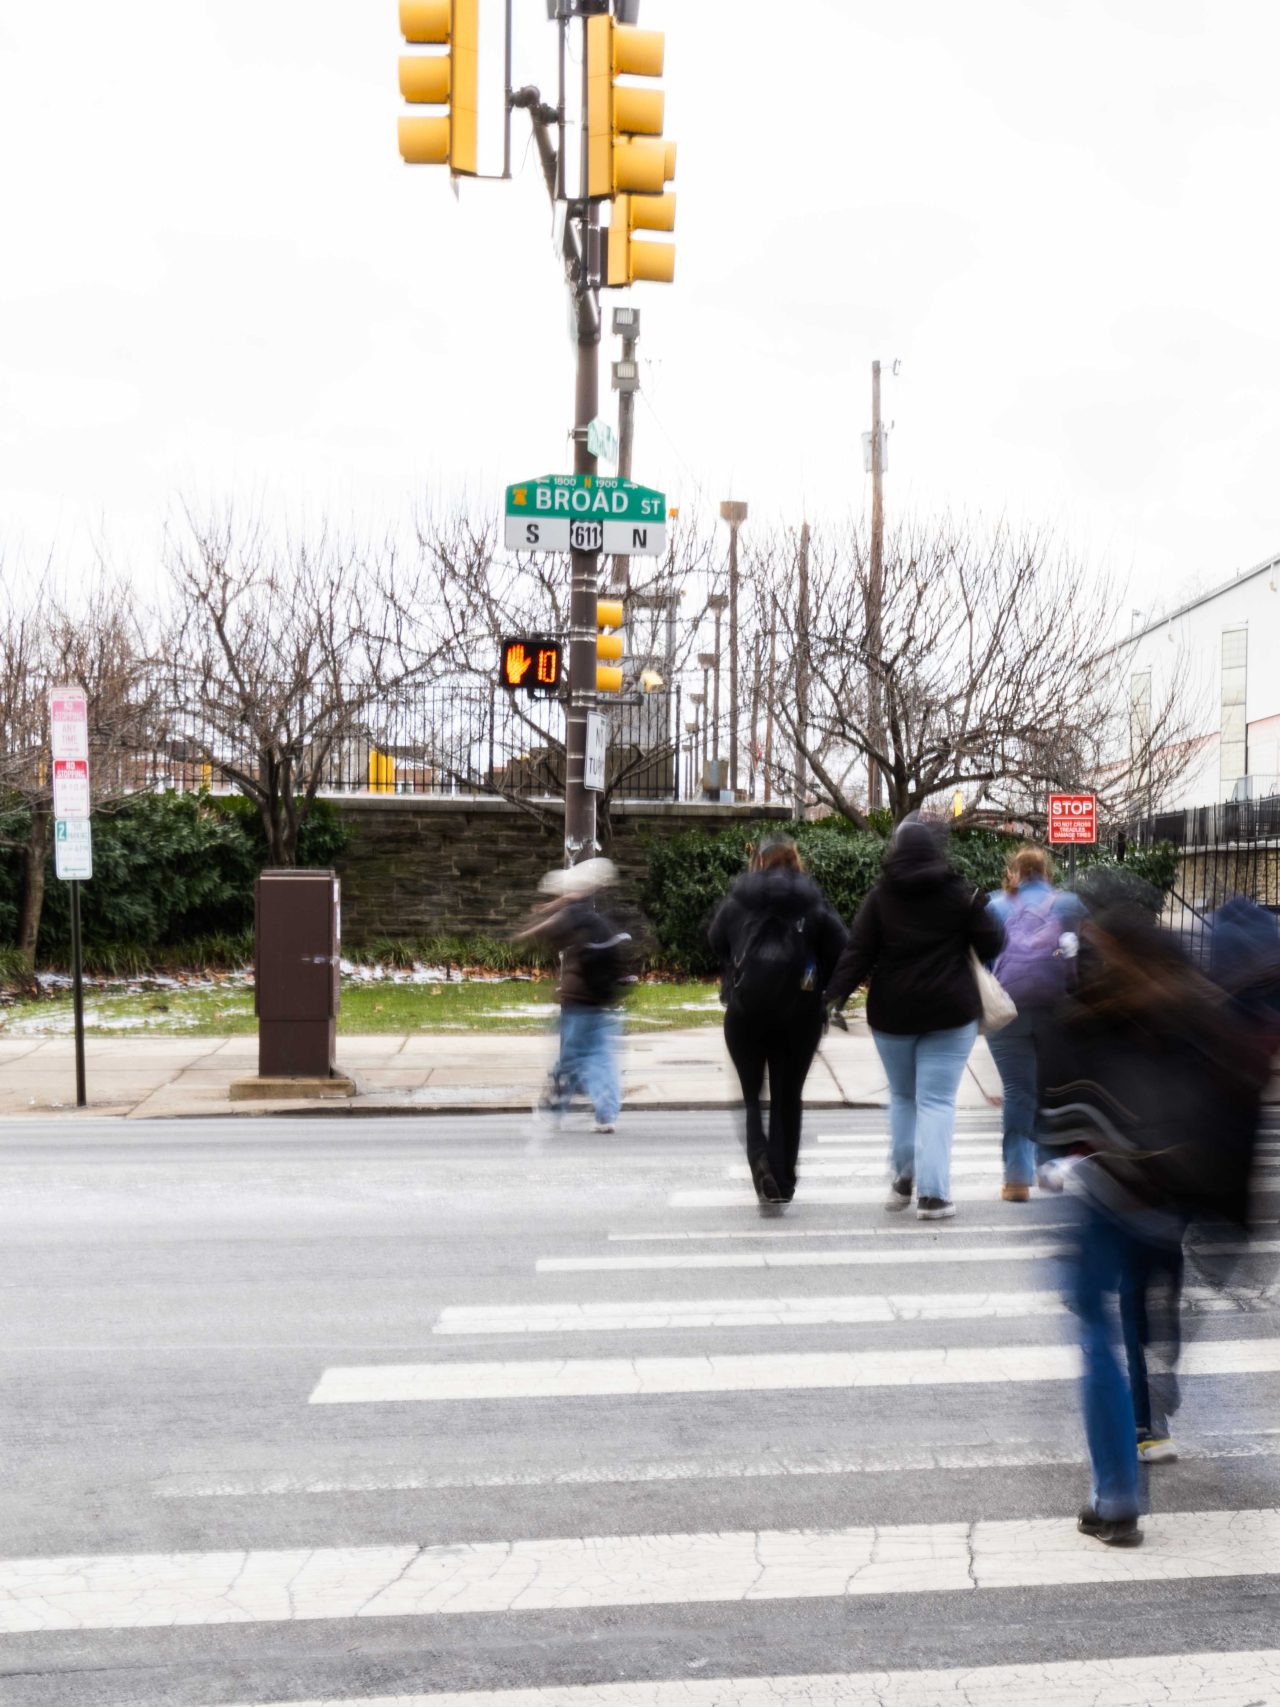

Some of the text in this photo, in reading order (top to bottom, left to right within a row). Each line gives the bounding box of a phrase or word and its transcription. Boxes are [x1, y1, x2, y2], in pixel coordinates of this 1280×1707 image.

[554, 476, 577, 487] 1800
[596, 479, 618, 489] 1900
[536, 486, 661, 515] BROAD ST
[526, 523, 540, 544] S
[575, 526, 598, 547] 611
[632, 528, 647, 548] N
[62, 723, 77, 733] ANY
[62, 735, 78, 745] TIME
[66, 760, 76, 770] NO
[57, 770, 87, 778] STOPPING
[1052, 800, 1093, 815] STOP
[58, 823, 65, 839] 2
